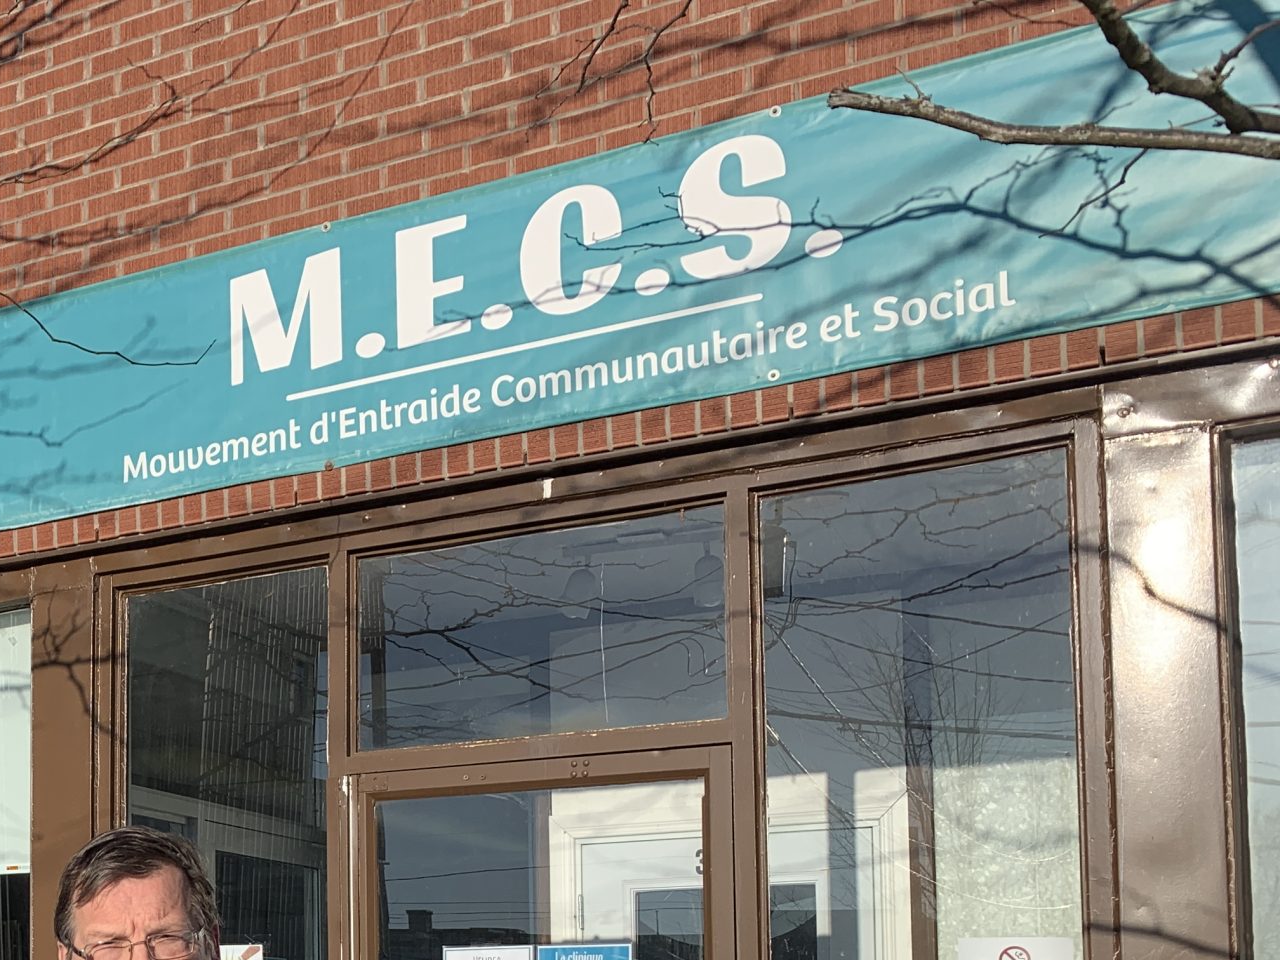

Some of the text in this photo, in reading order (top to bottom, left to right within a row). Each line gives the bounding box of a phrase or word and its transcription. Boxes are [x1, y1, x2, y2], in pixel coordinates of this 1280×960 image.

[230, 134, 843, 386] M.E.C.S.
[122, 270, 1016, 483] Mouvement d'Entraide Communautaire et Social
